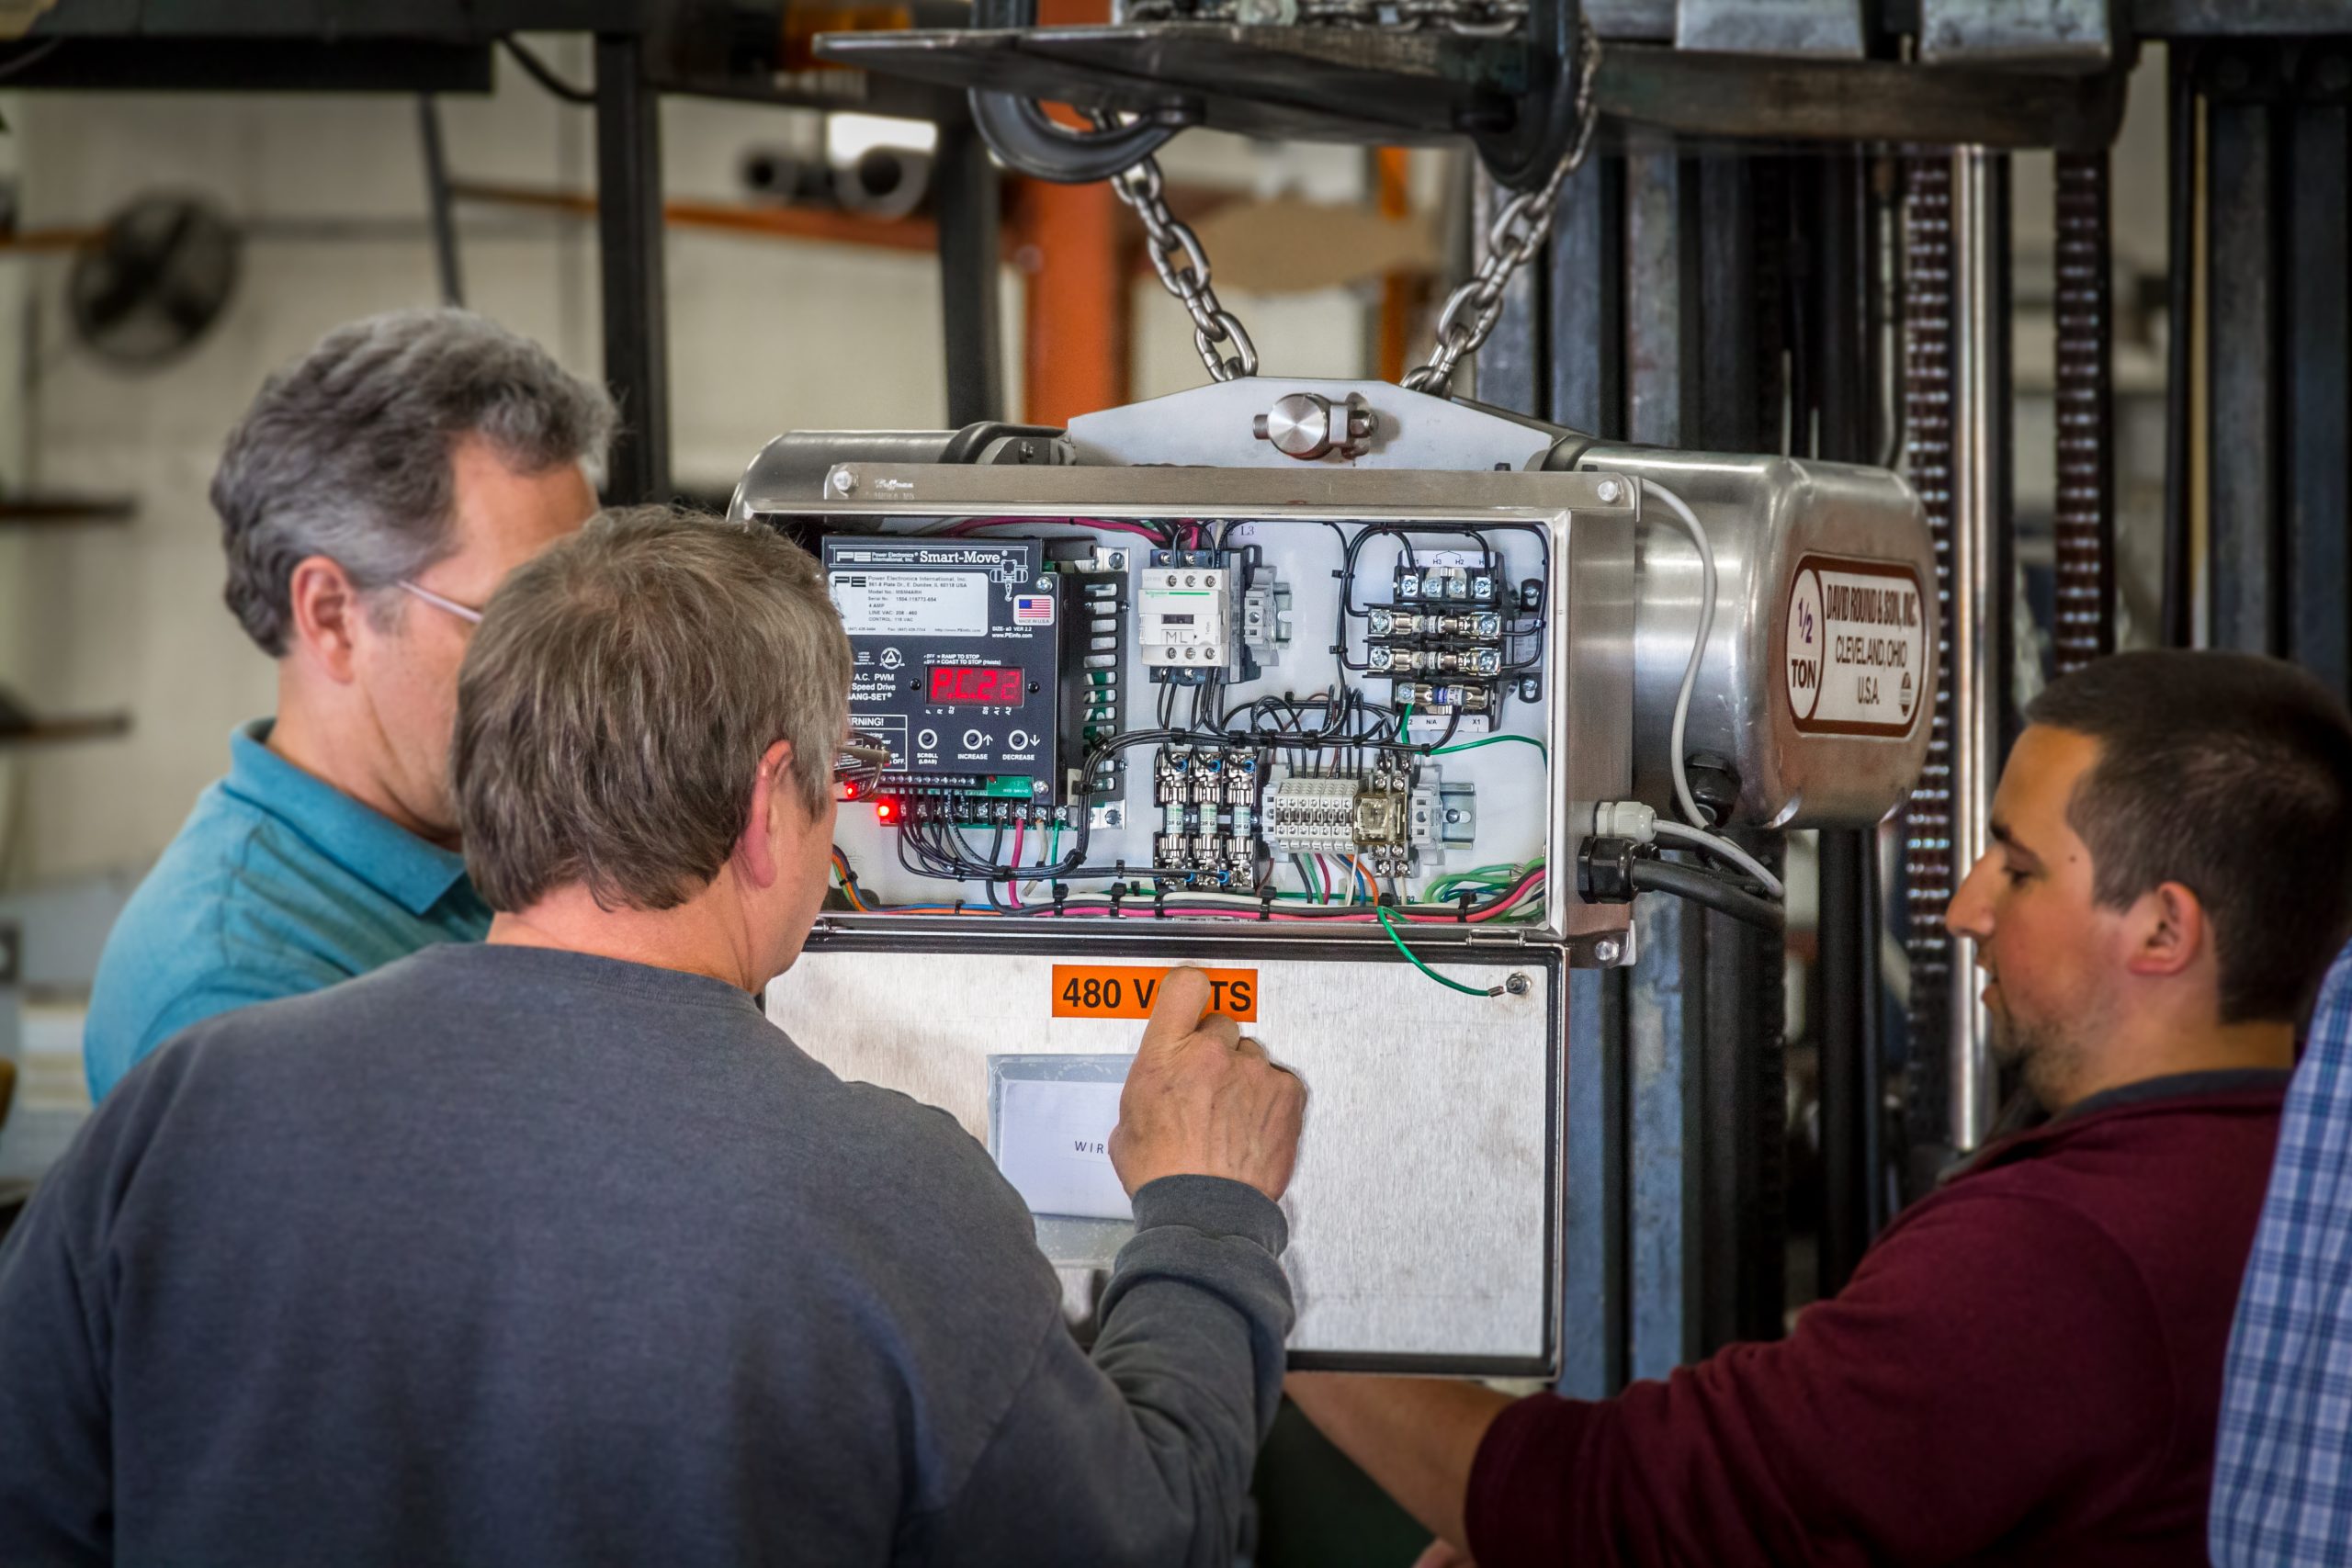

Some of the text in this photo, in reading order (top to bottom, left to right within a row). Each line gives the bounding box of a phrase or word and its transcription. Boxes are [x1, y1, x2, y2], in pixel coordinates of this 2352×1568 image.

[1241, 526, 1254, 536] L3
[919, 550, 1001, 564] Smart-Move
[1826, 584, 1849, 622] DAVID
[1850, 587, 1876, 624] ROUND
[1798, 597, 1813, 644] 1/2
[1887, 639, 1907, 668] OHIO
[874, 673, 895, 682] PWM
[1792, 659, 1816, 689] TON
[852, 682, 896, 692] Speed Drive
[1063, 977, 1251, 1012] 480 VTS
[1074, 1140, 1104, 1155] WIR
